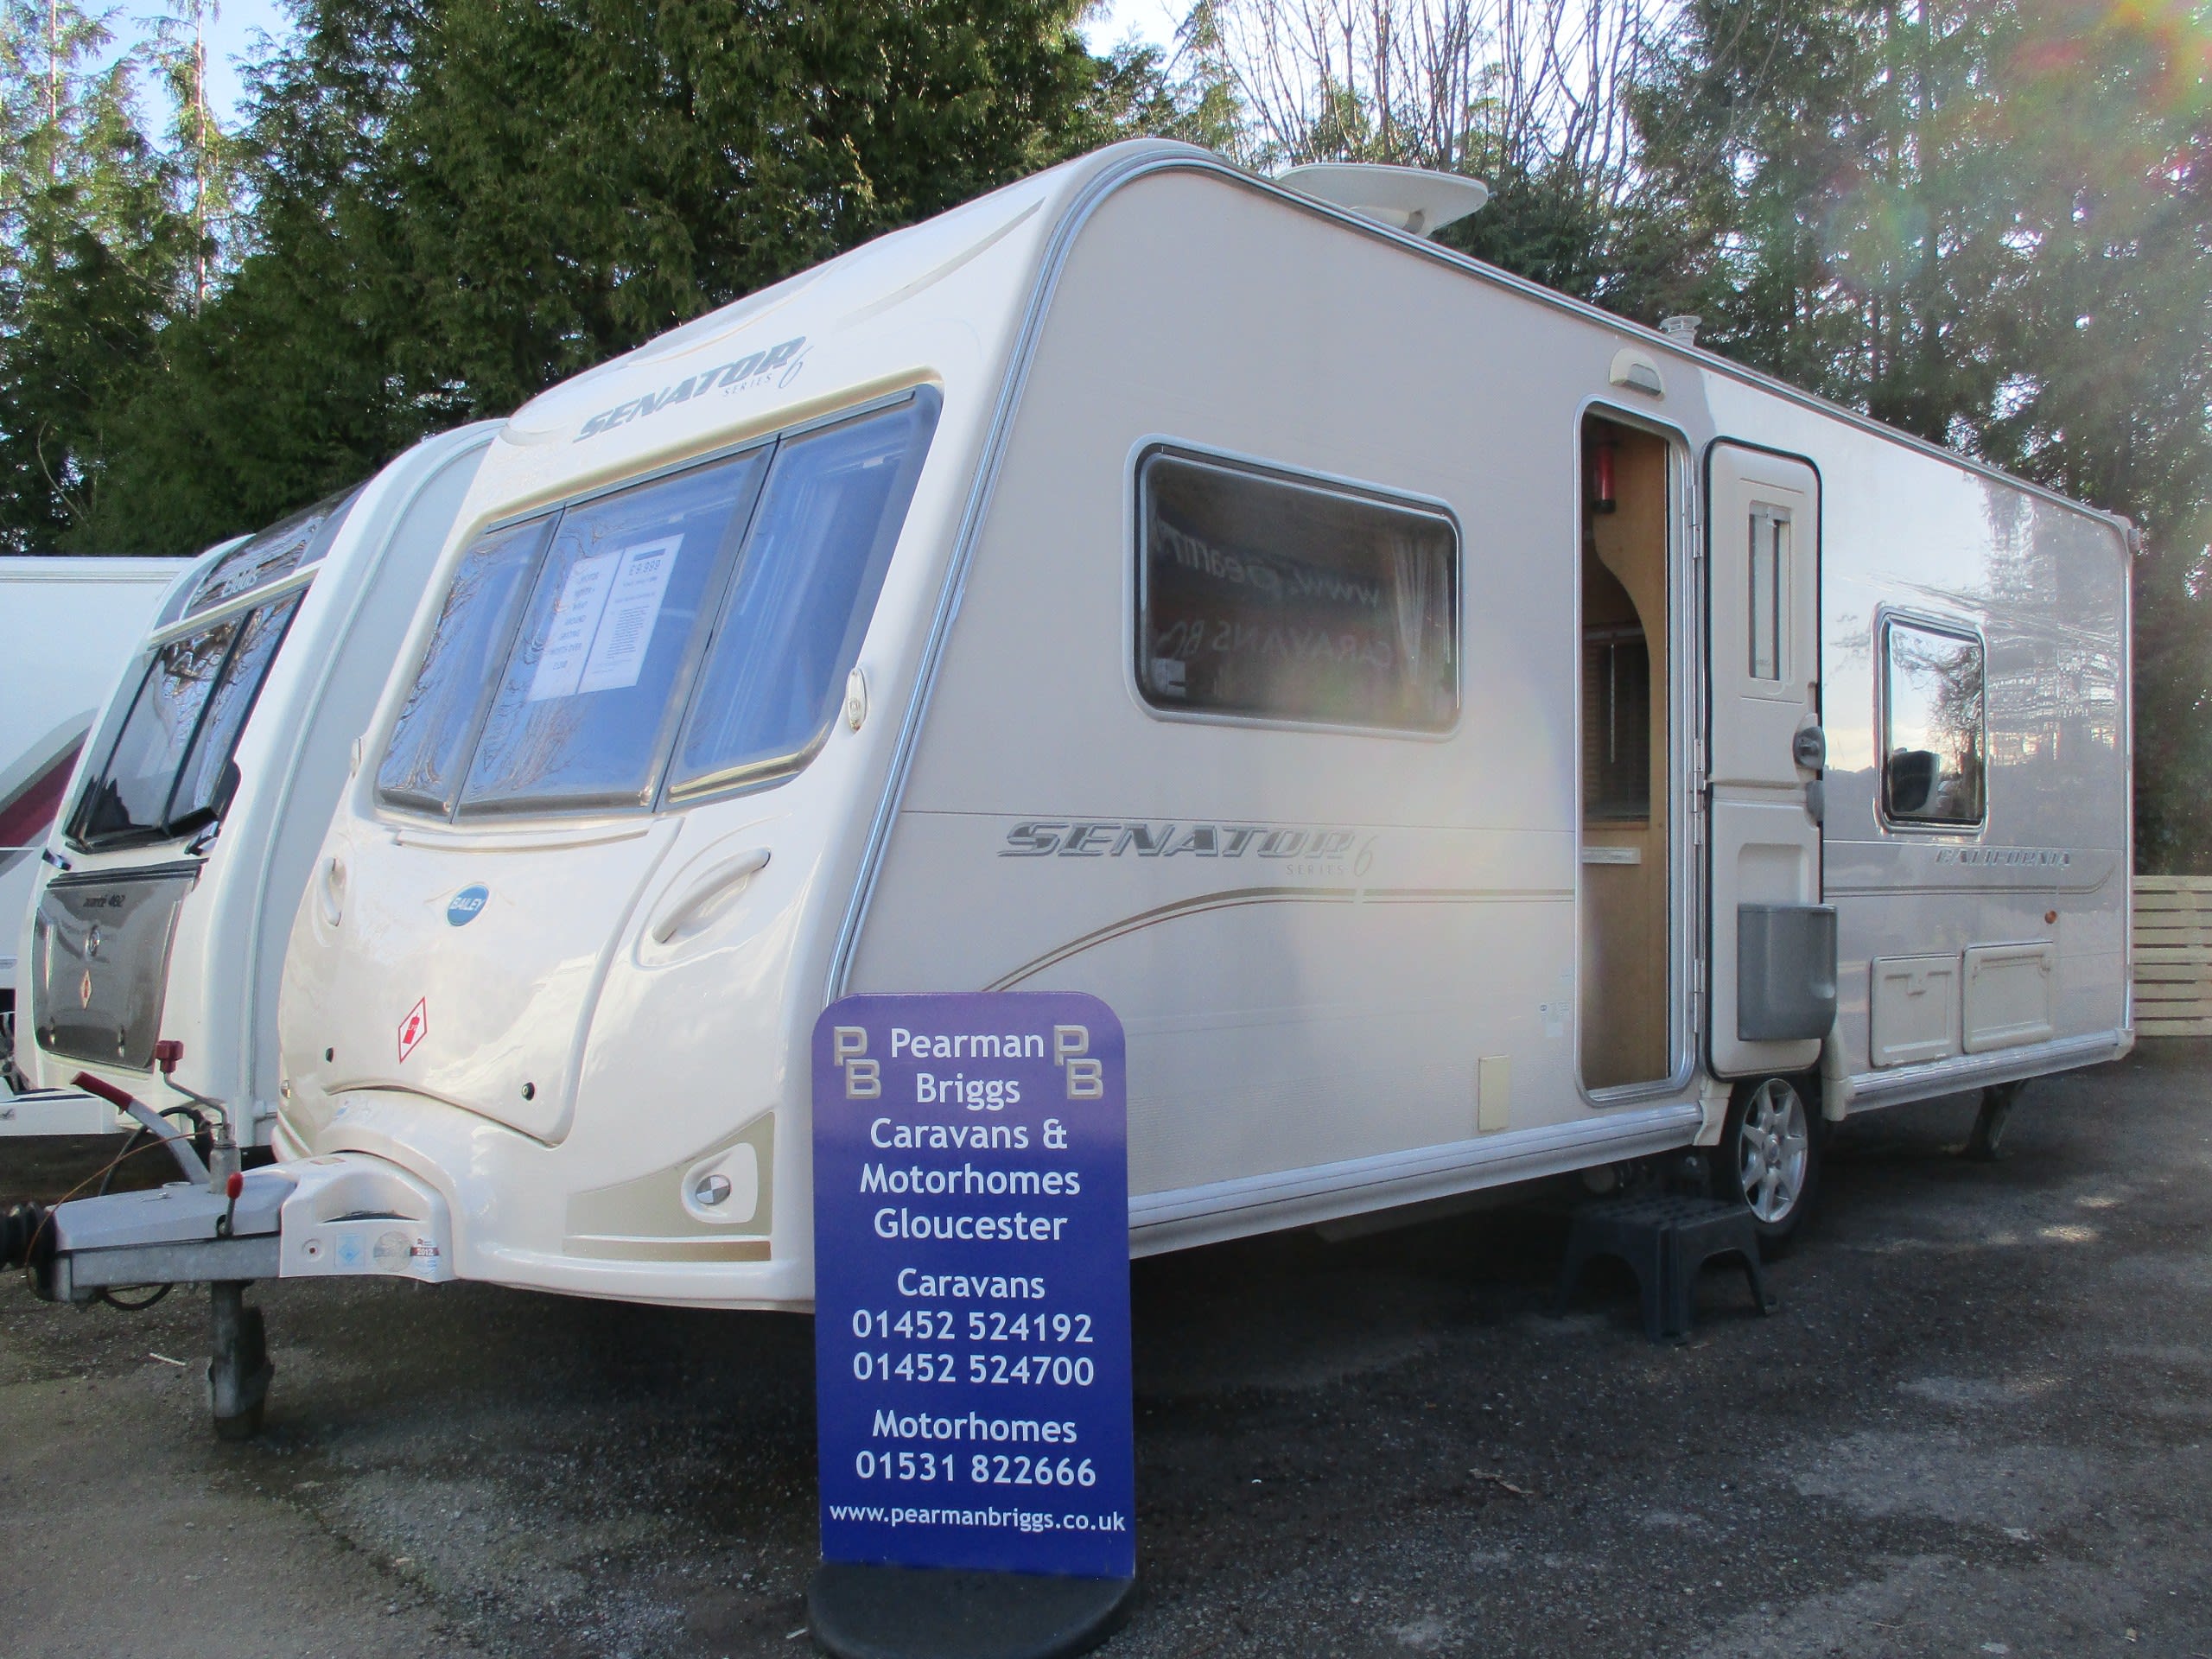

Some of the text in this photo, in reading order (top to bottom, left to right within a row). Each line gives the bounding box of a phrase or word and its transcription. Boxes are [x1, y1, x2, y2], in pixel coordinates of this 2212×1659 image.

[573, 335, 806, 443] SENATOR
[997, 821, 1356, 859] SENATOR
[1285, 835, 1379, 878] SERIES 6
[448, 897, 484, 912] BAILEY
[891, 1027, 1044, 1058] Pearman
[916, 1072, 1020, 1111] Briggs
[870, 1117, 1068, 1149] Caravans &
[860, 1162, 1081, 1195] Motorhomes
[874, 1207, 1069, 1241] Gloucester
[416, 1247, 435, 1256] 2012
[897, 1268, 1046, 1300] Caravans
[852, 1309, 1094, 1343] 01452 524192
[853, 1351, 1094, 1387] 01452 524700
[872, 1409, 1077, 1444] Motorhomes
[855, 1450, 1096, 1487] 01531 822666
[830, 1505, 1126, 1533] www.pearmanbriggs.co.uk
